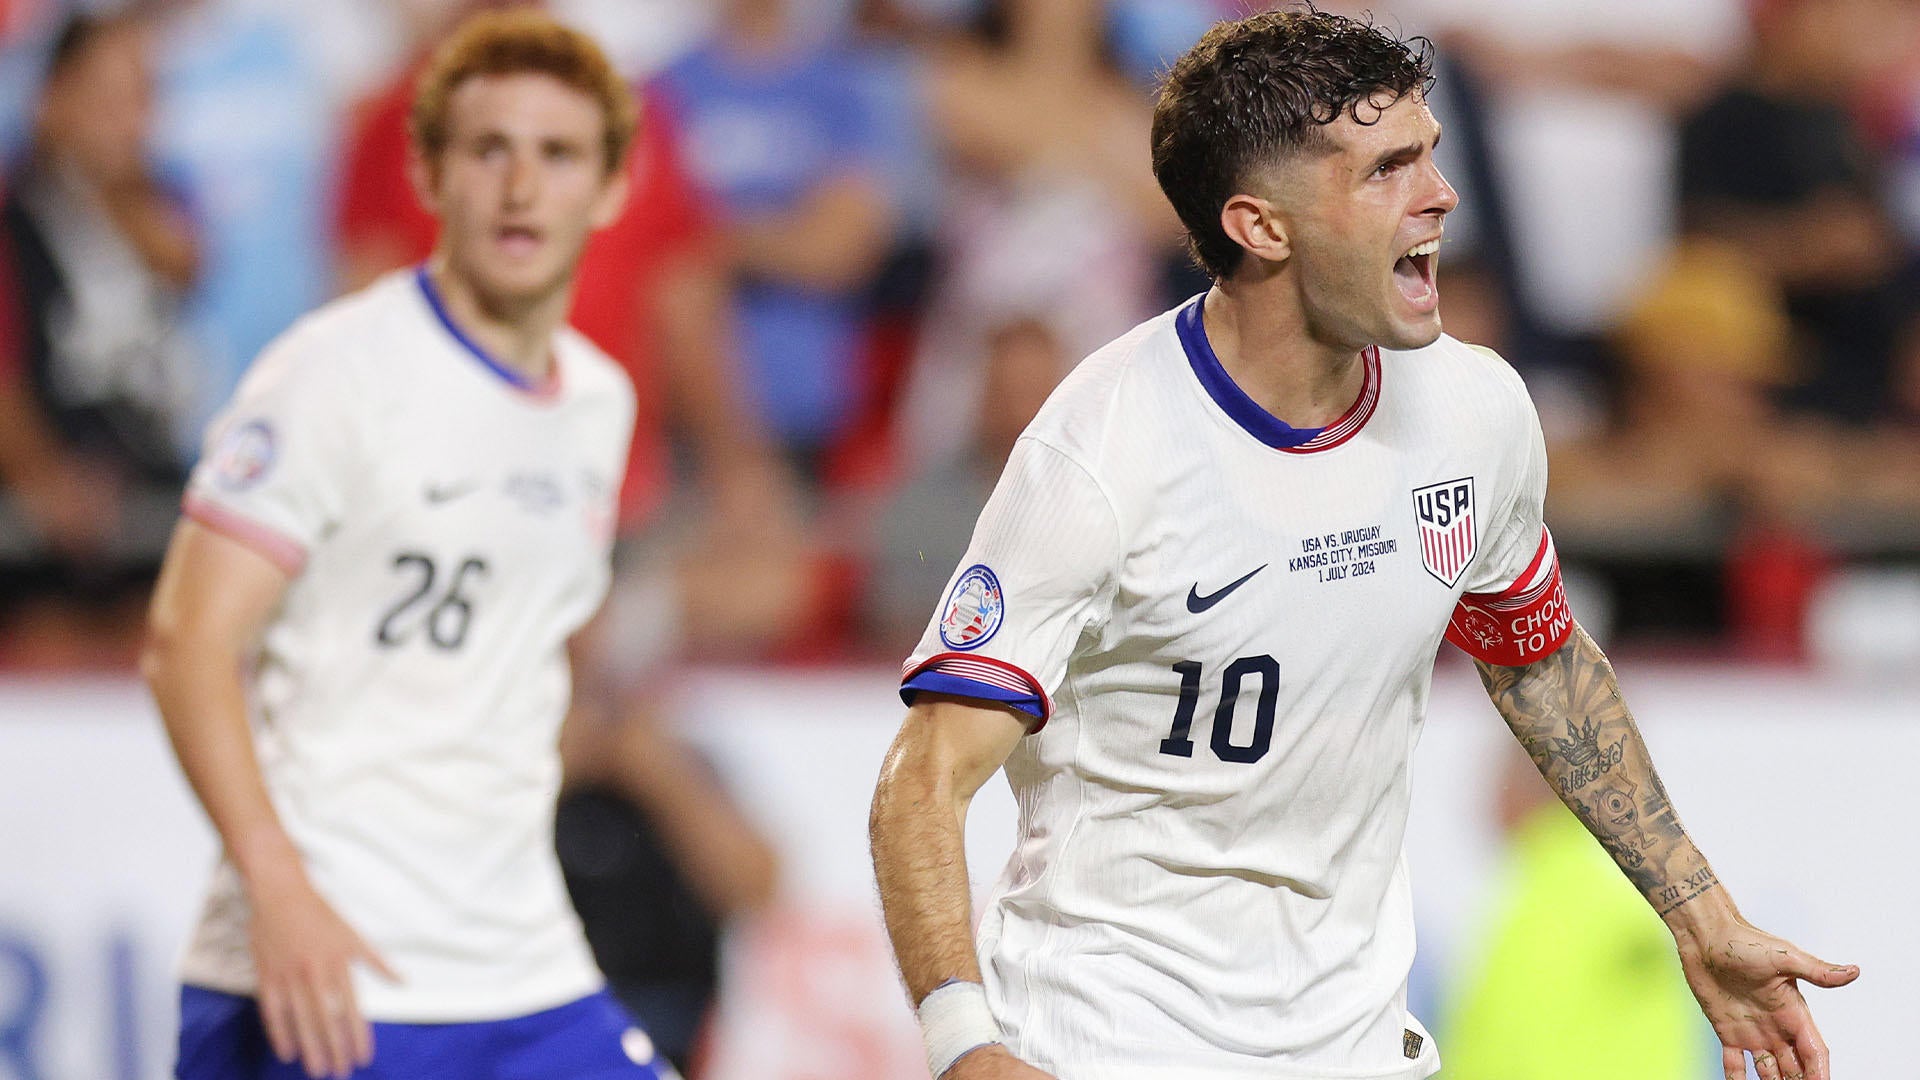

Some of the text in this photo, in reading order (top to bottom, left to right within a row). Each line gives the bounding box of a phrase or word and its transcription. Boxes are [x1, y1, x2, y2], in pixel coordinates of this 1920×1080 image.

[1418, 485, 1469, 527] USA
[1289, 552, 1328, 572] KANSAS
[1358, 539, 1397, 559] MISSOURI
[1302, 525, 1381, 553] USA VS. URUGUAY
[1318, 560, 1375, 583] 1 JULY 2024
[375, 550, 491, 651] 26
[1513, 633, 1545, 657] TO
[1159, 654, 1280, 764] 10
